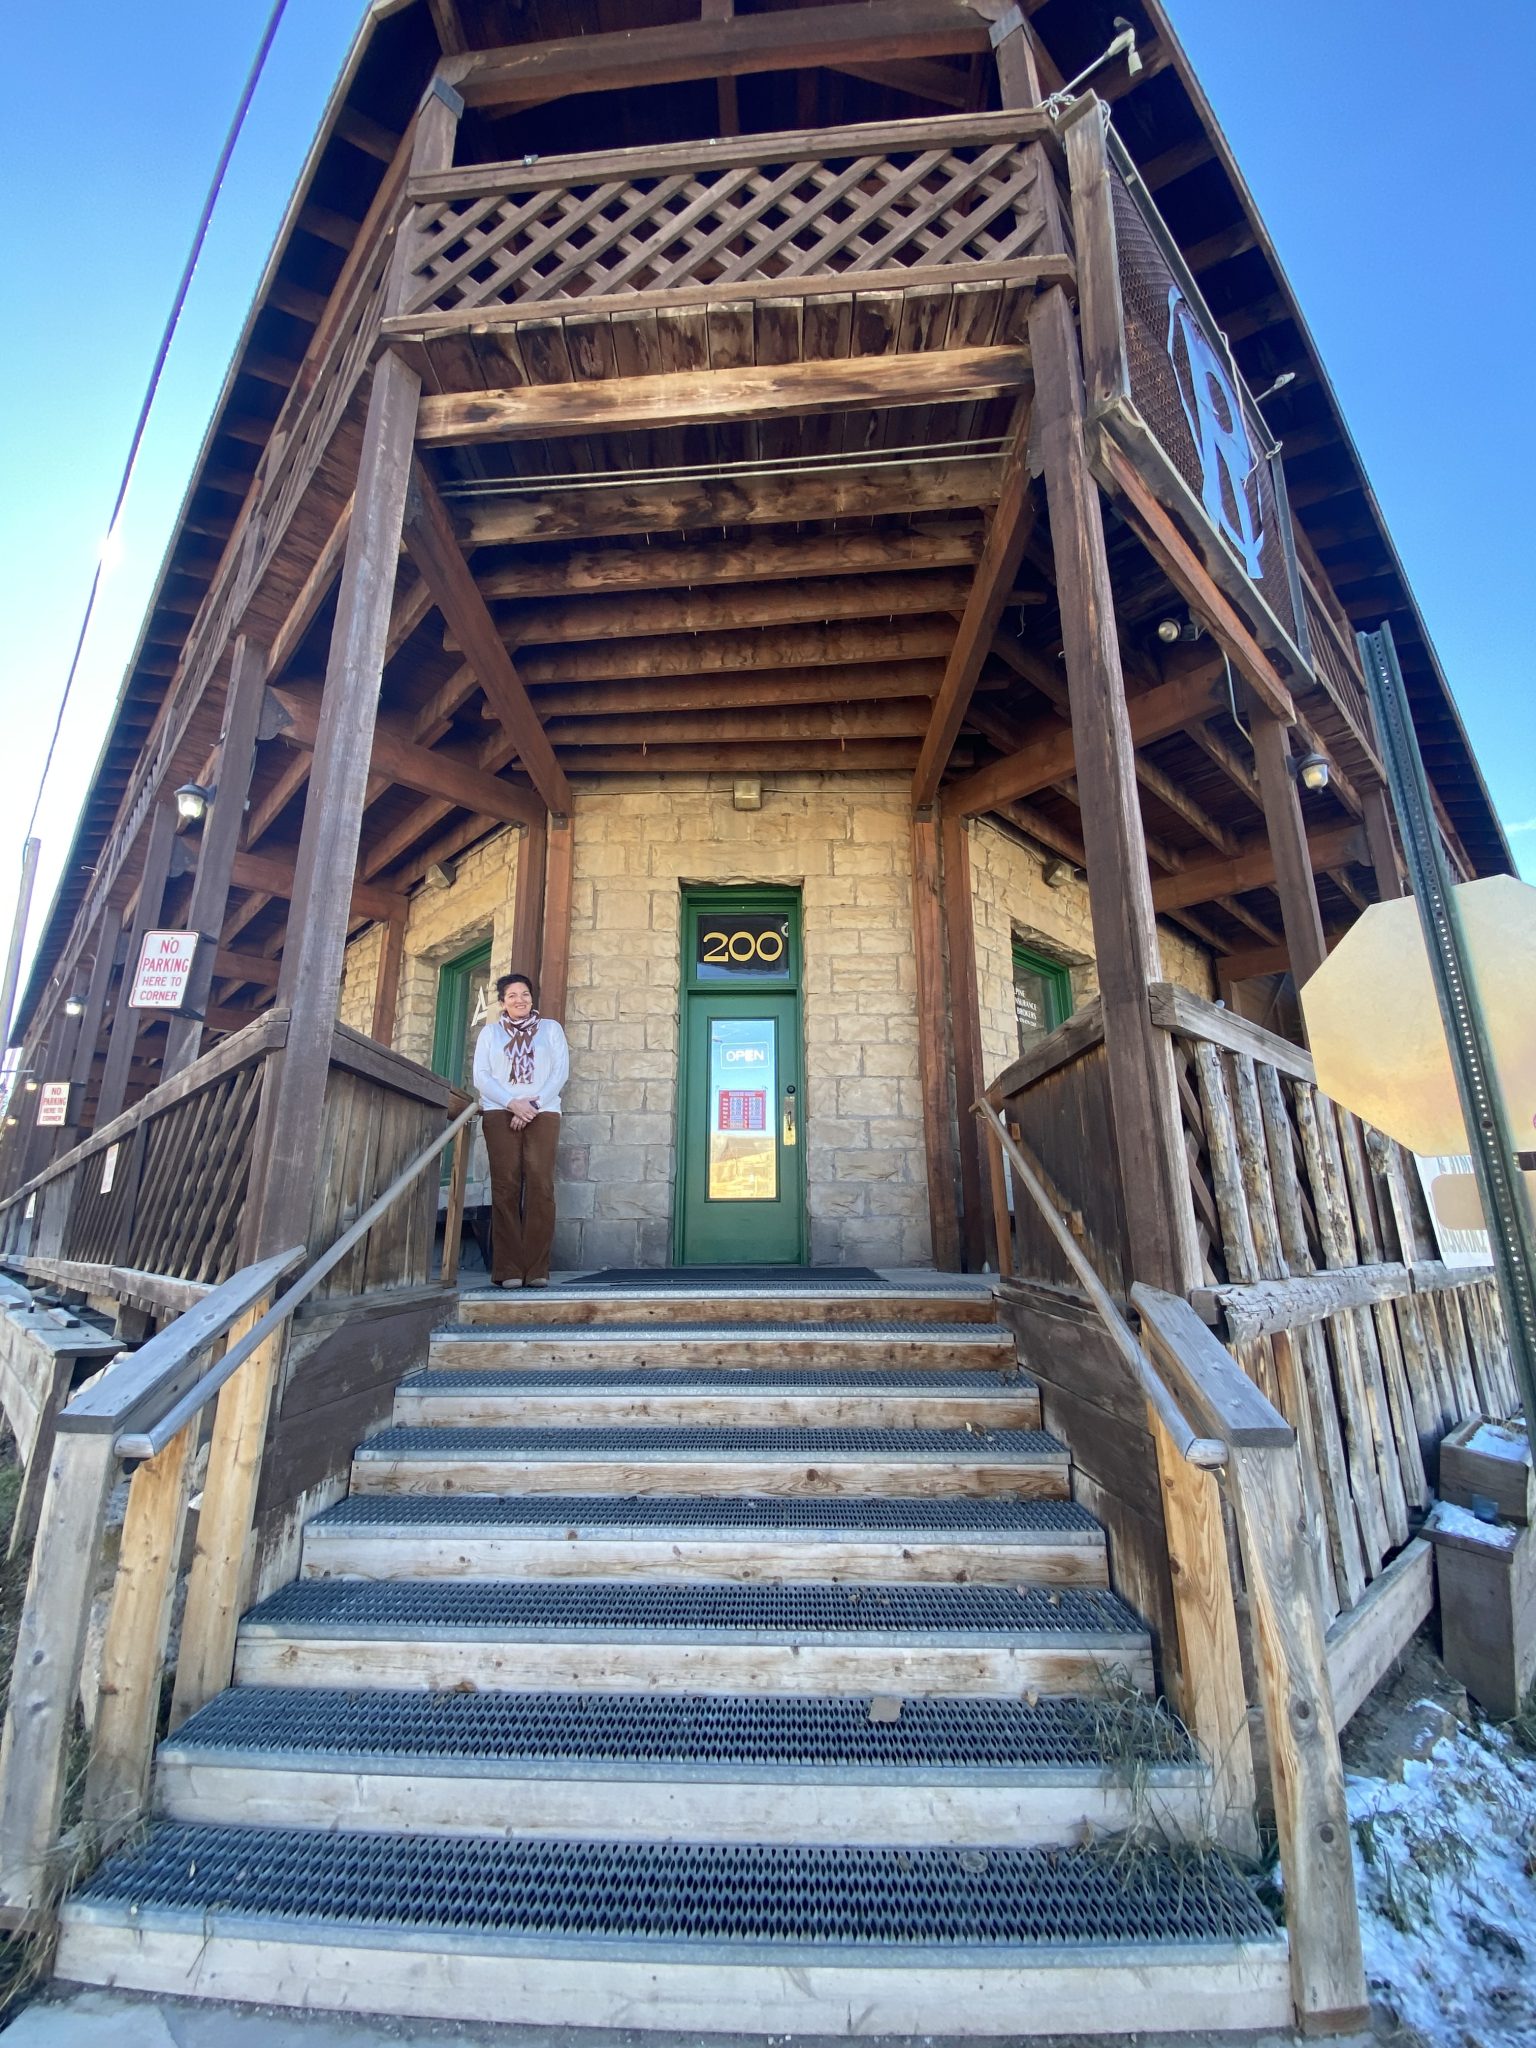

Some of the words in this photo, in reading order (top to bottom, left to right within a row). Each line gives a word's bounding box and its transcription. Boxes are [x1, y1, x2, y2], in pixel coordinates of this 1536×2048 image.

[160, 939, 179, 954] NO
[703, 931, 783, 962] 200
[142, 957, 189, 973] PARKING
[142, 976, 167, 987] HERE
[171, 976, 182, 987] TO
[139, 990, 178, 1001] CORNER
[1015, 997, 1037, 1011] NSURANCE
[726, 1049, 765, 1062] OPEN
[51, 1087, 62, 1096] NO
[43, 1097, 67, 1106] PARKING
